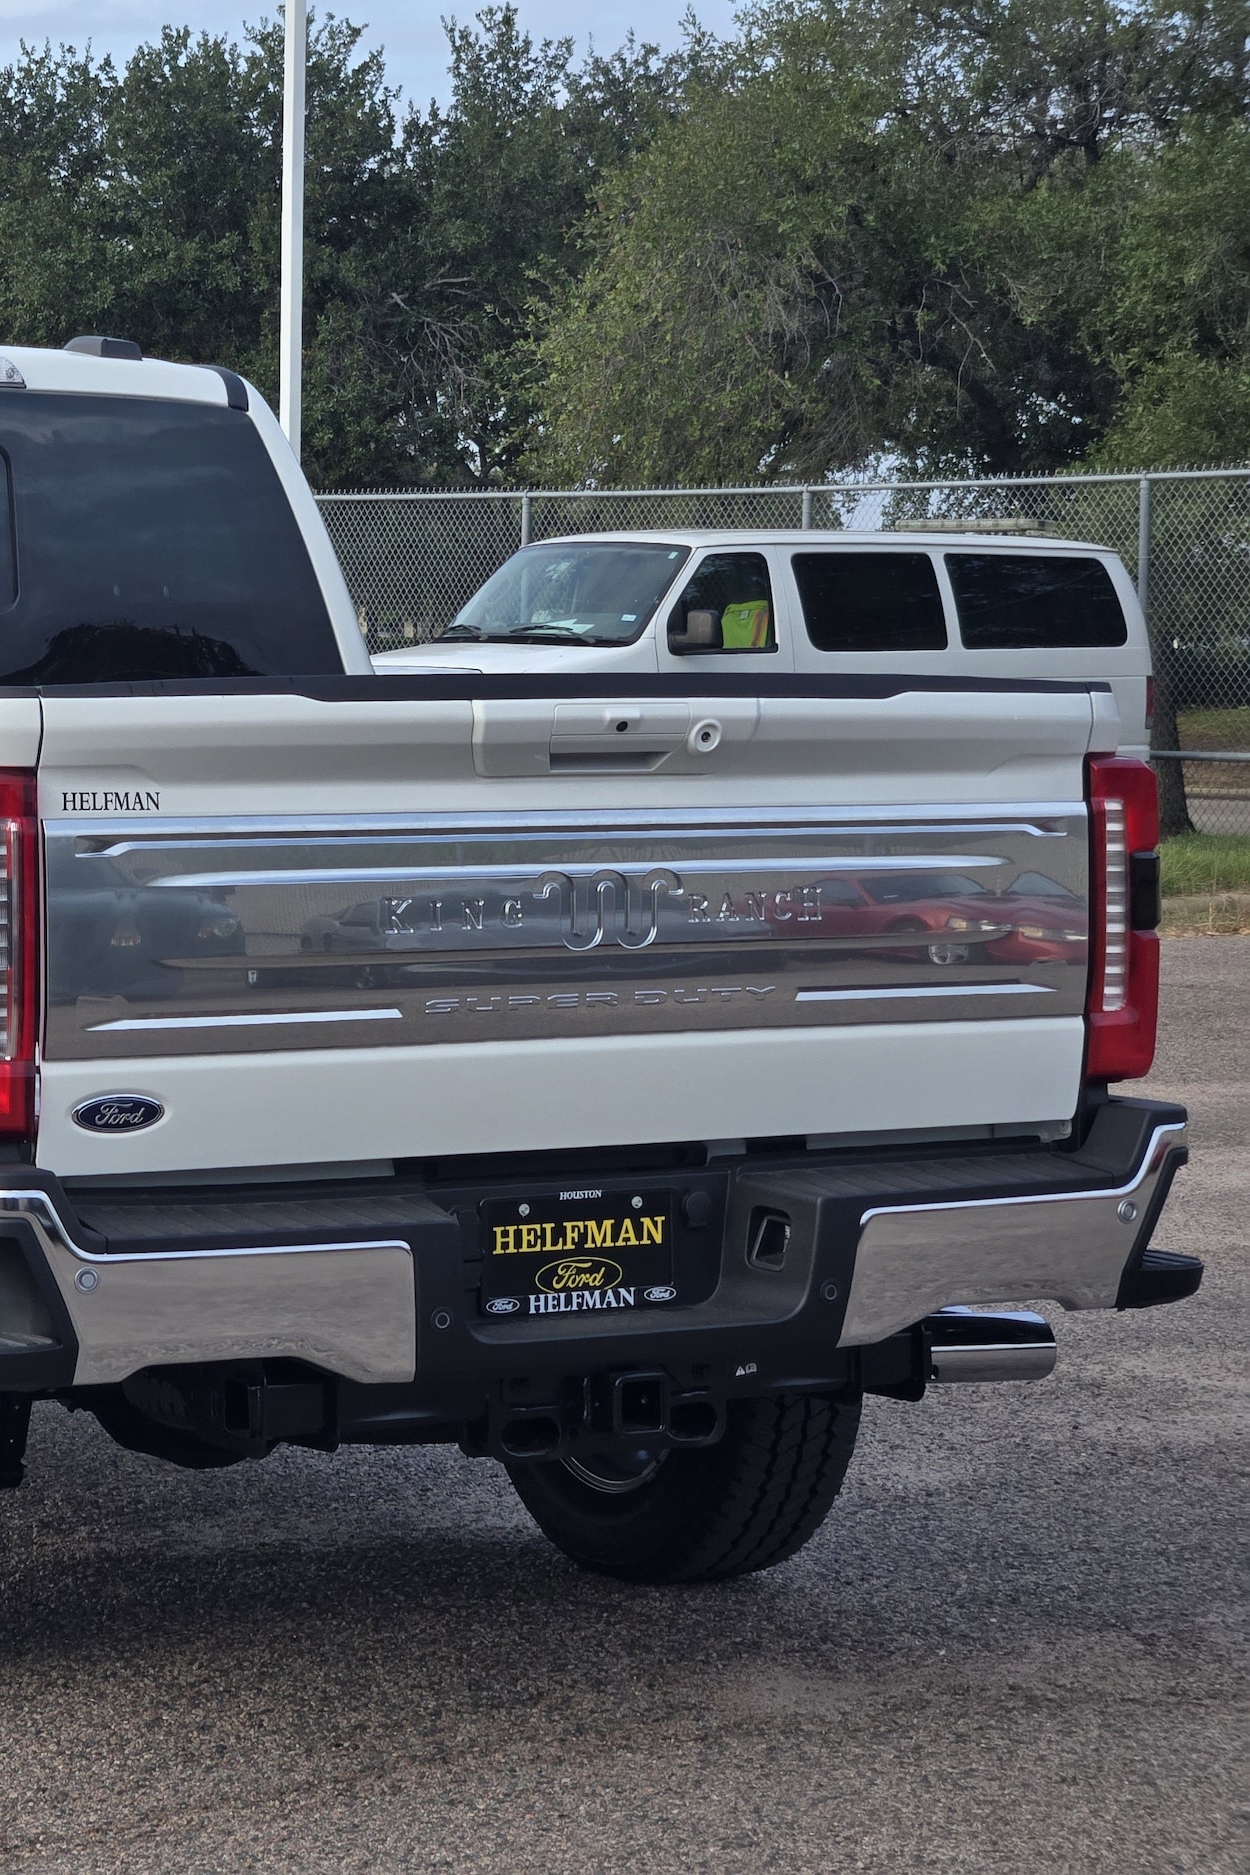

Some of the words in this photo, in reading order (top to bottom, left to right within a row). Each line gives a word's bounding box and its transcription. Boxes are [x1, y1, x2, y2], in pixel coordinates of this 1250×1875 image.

[61, 792, 161, 812] HELFMAN
[383, 896, 524, 935] KING
[687, 886, 824, 923] RANCH
[424, 989, 619, 1015] SUPER
[634, 985, 777, 1007] DUTY
[94, 1102, 146, 1126] Ford
[559, 1189, 603, 1201] HOUSTON
[492, 1215, 666, 1255] HELFMAN
[552, 1261, 606, 1290] Ford
[528, 1287, 637, 1315] HELFMAN
